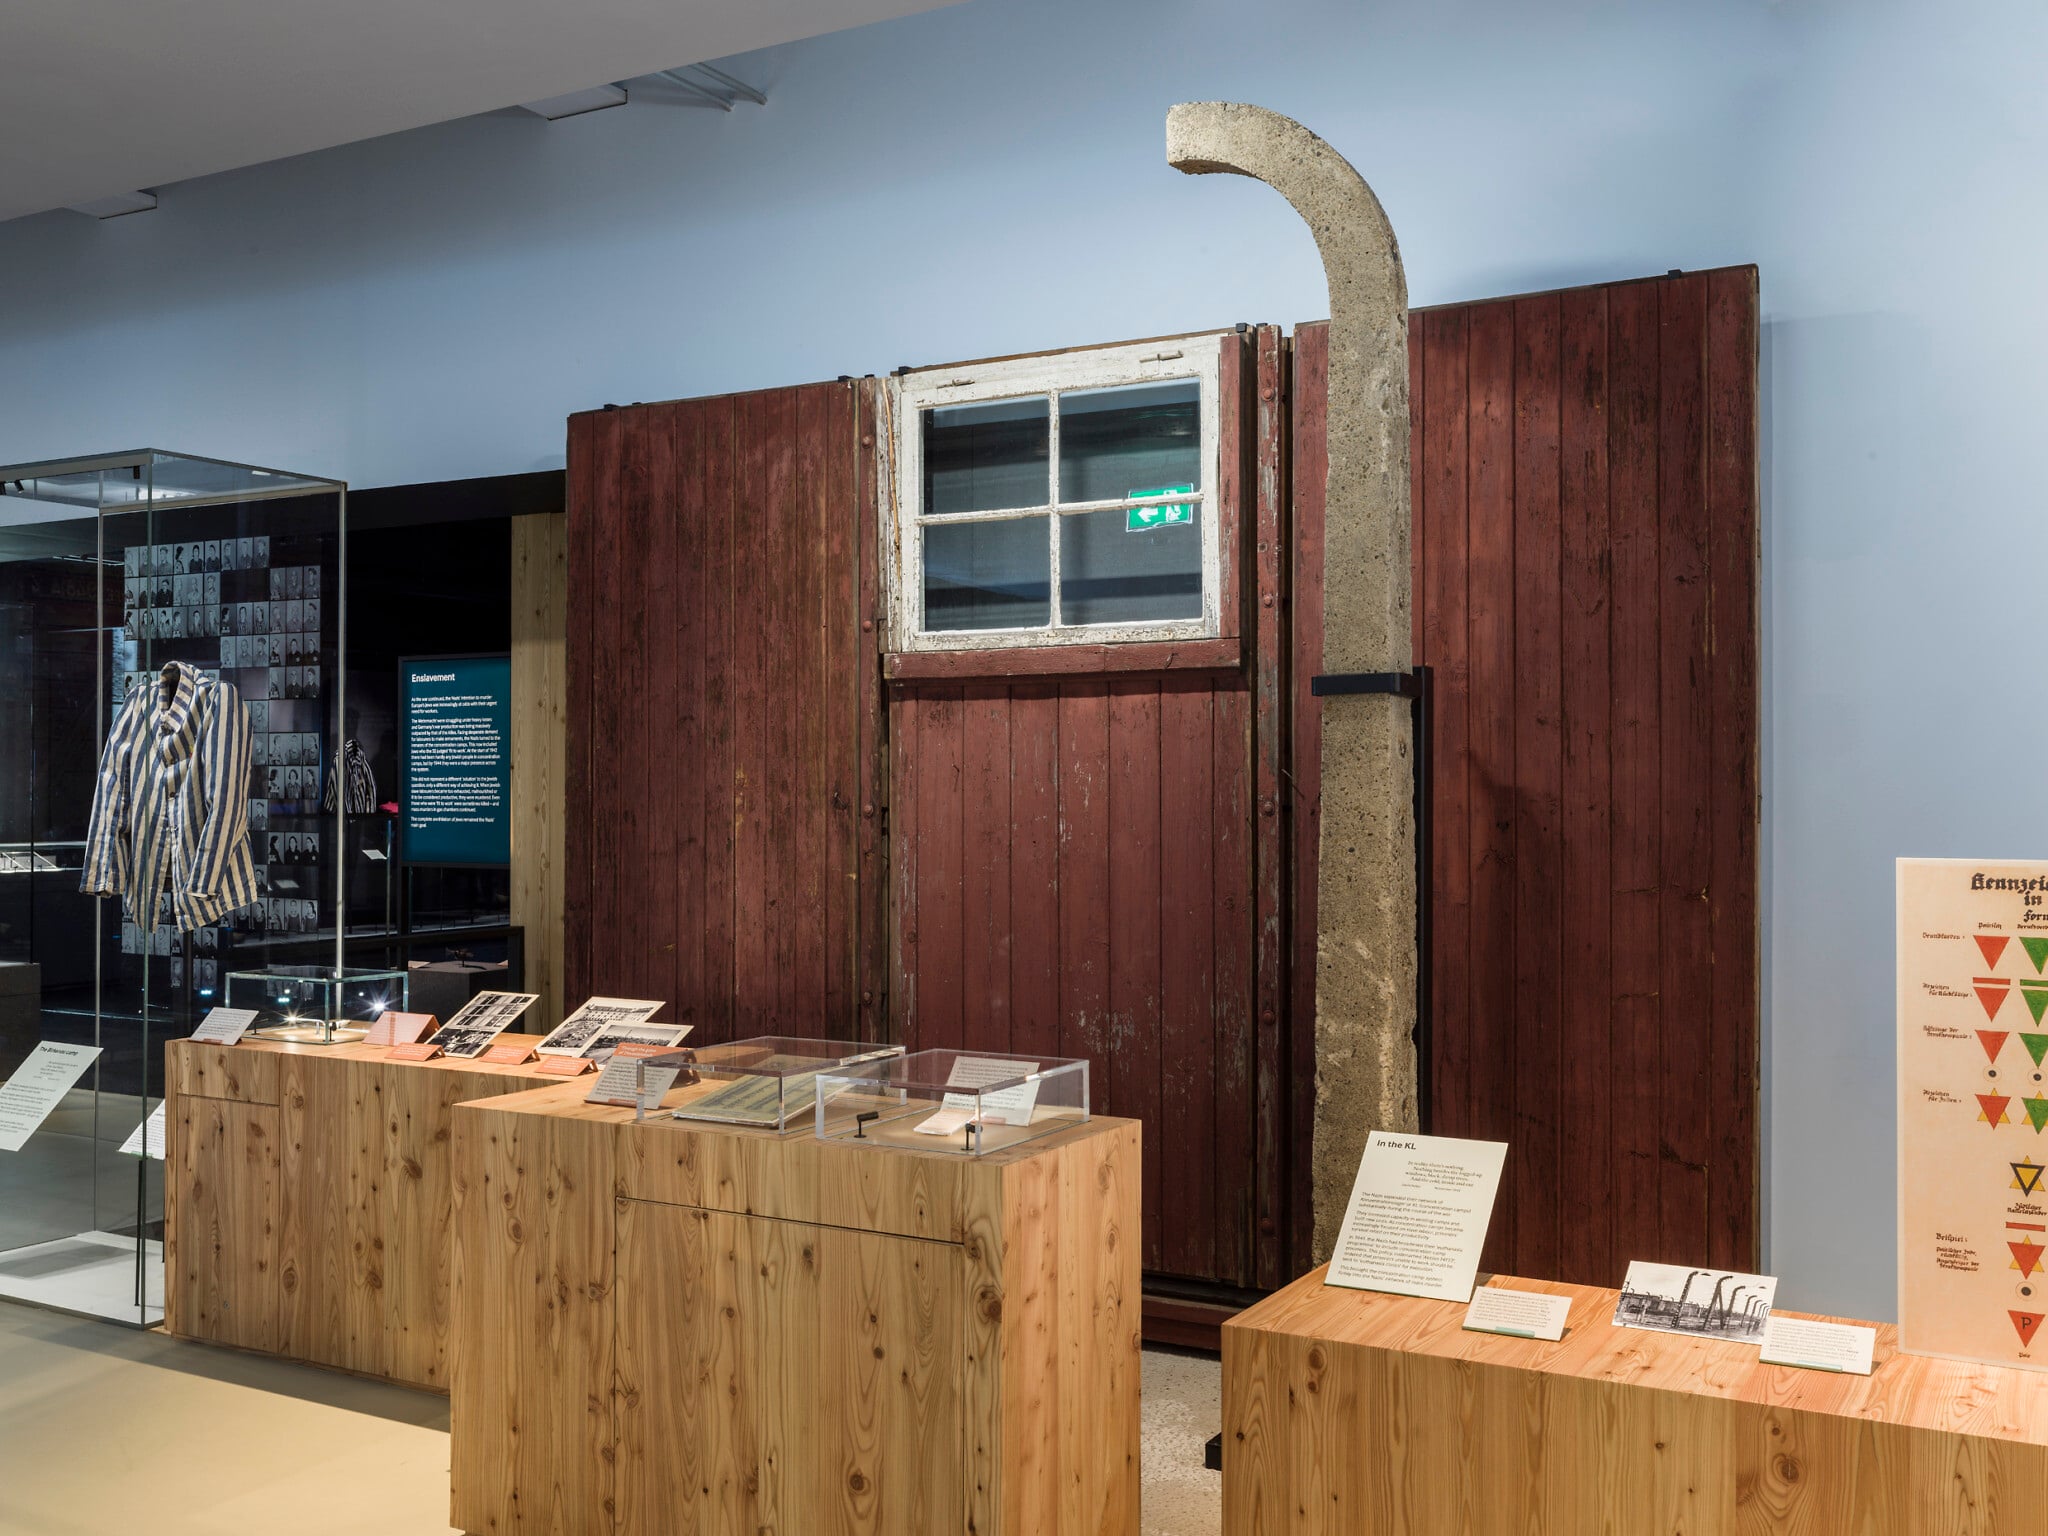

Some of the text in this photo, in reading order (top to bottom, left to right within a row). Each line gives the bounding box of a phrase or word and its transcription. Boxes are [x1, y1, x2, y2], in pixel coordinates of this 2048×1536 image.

[412, 673, 455, 683] Enslavement
[2024, 890, 2042, 906] in
[2021, 1317, 2032, 1329] P
